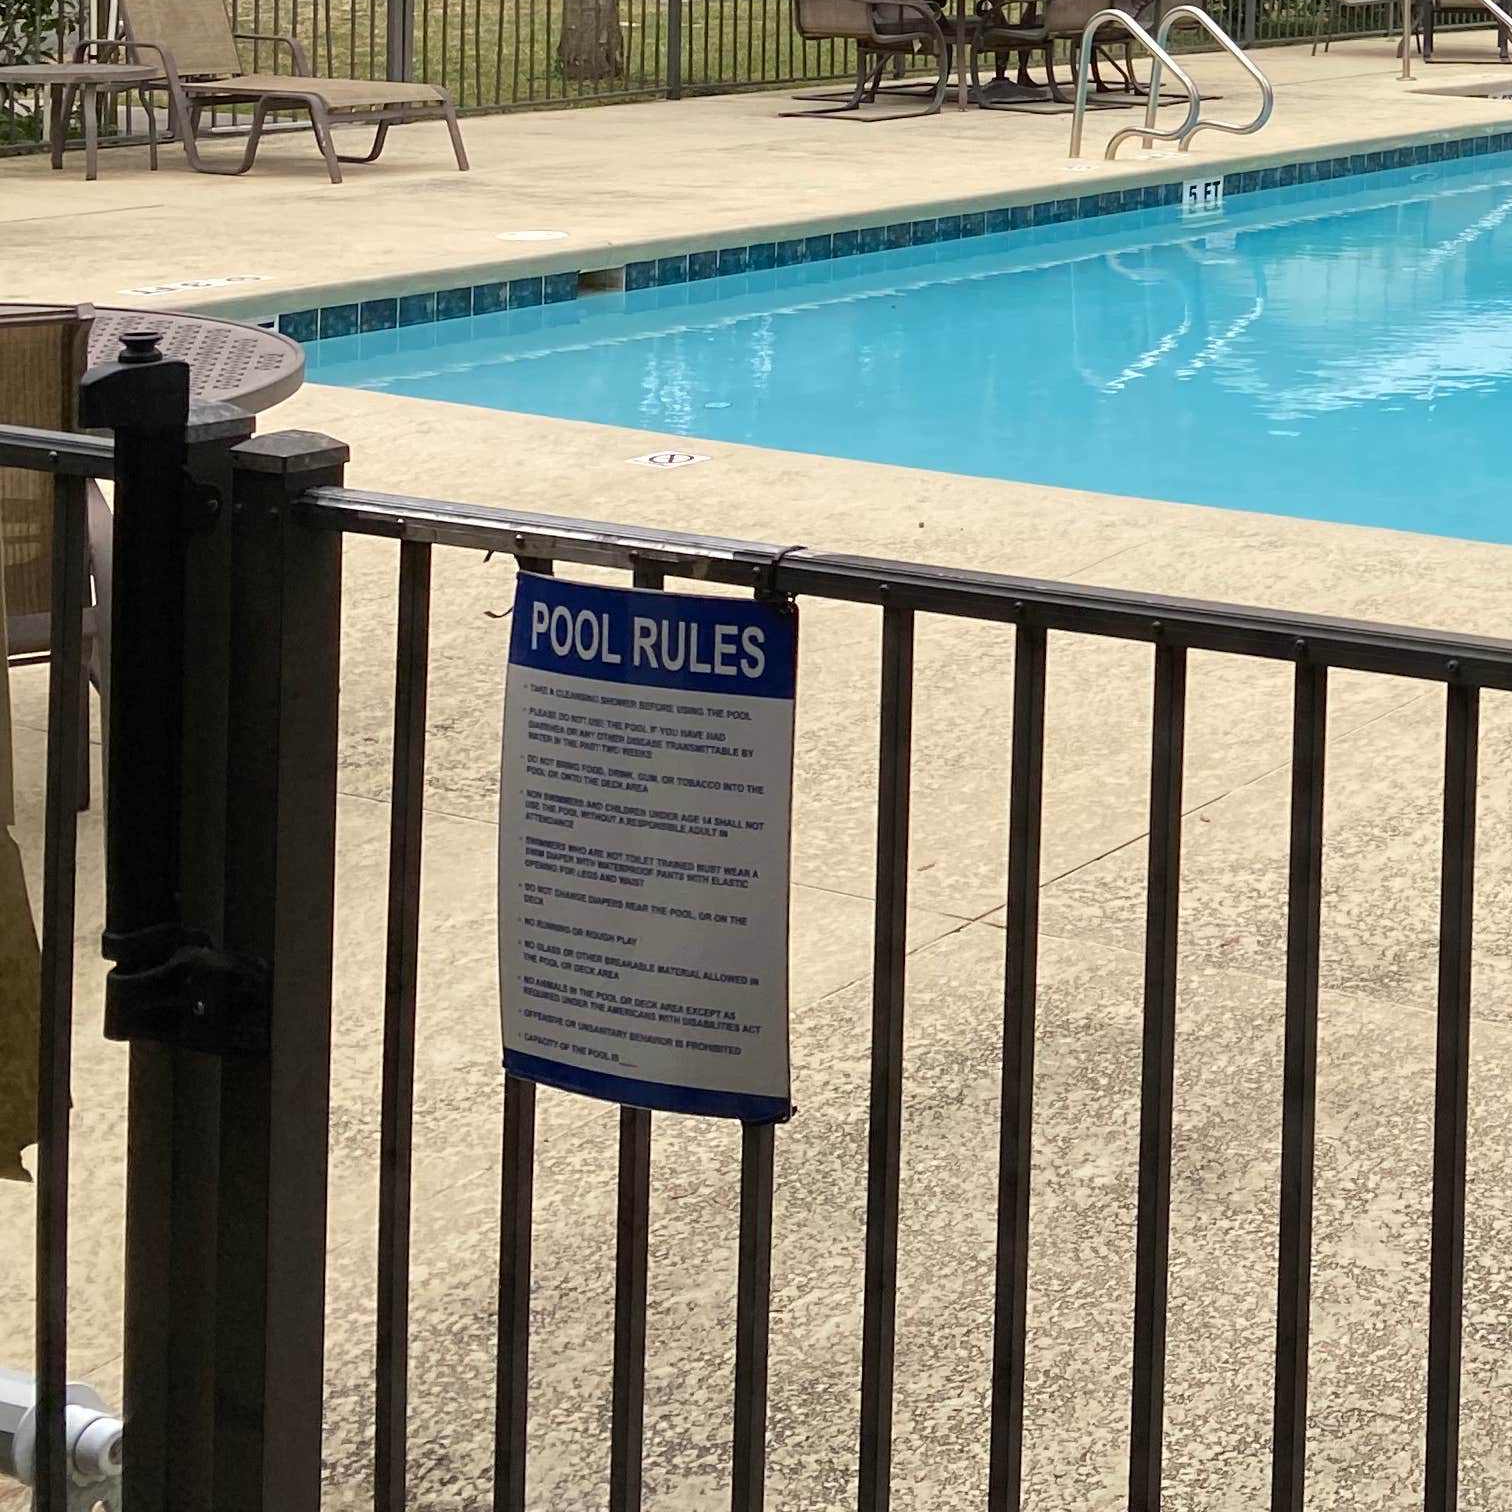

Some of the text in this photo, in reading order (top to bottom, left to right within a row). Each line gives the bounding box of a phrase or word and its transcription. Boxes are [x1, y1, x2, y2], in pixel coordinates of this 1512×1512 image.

[1204, 180, 1221, 201] FT
[531, 601, 766, 679] POOL RULES
